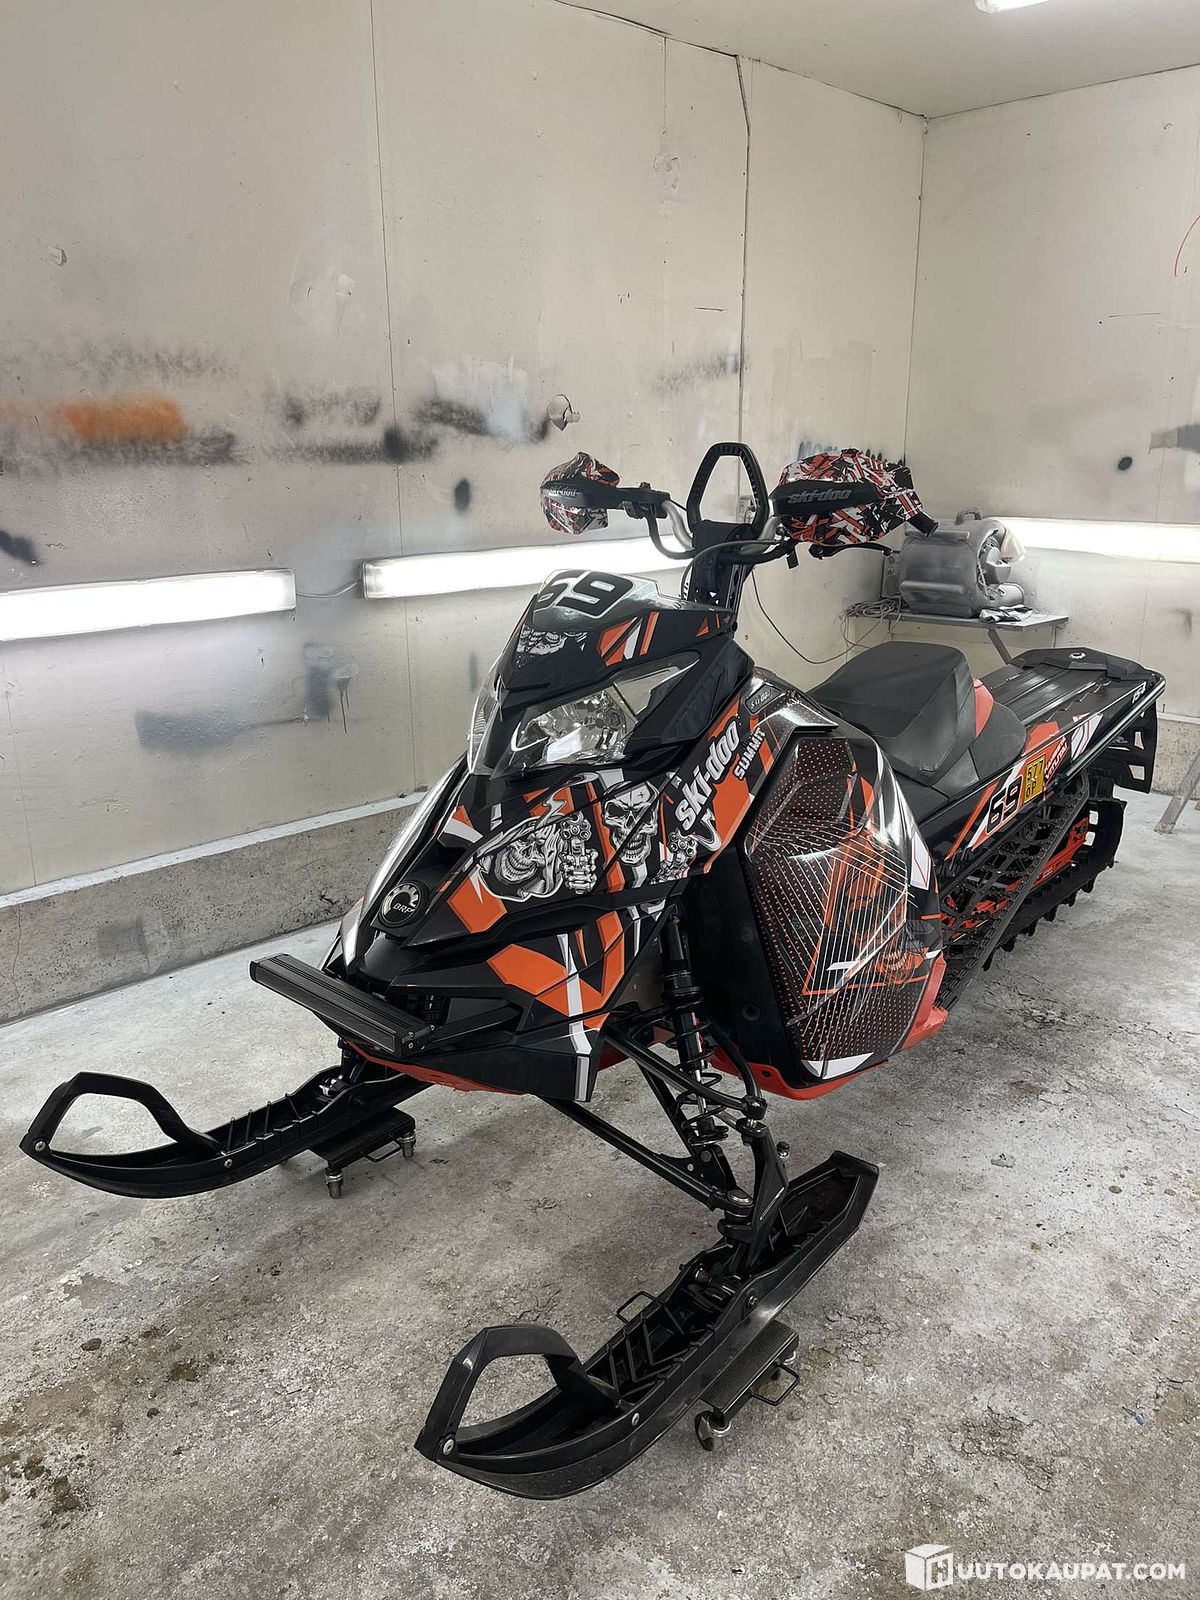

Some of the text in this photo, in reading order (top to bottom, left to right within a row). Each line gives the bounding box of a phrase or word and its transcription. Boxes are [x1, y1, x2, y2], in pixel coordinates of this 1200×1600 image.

[534, 569, 634, 616] 69
[733, 727, 766, 780] SUMMIT
[987, 775, 1022, 834] 69
[392, 902, 416, 914] BRP
